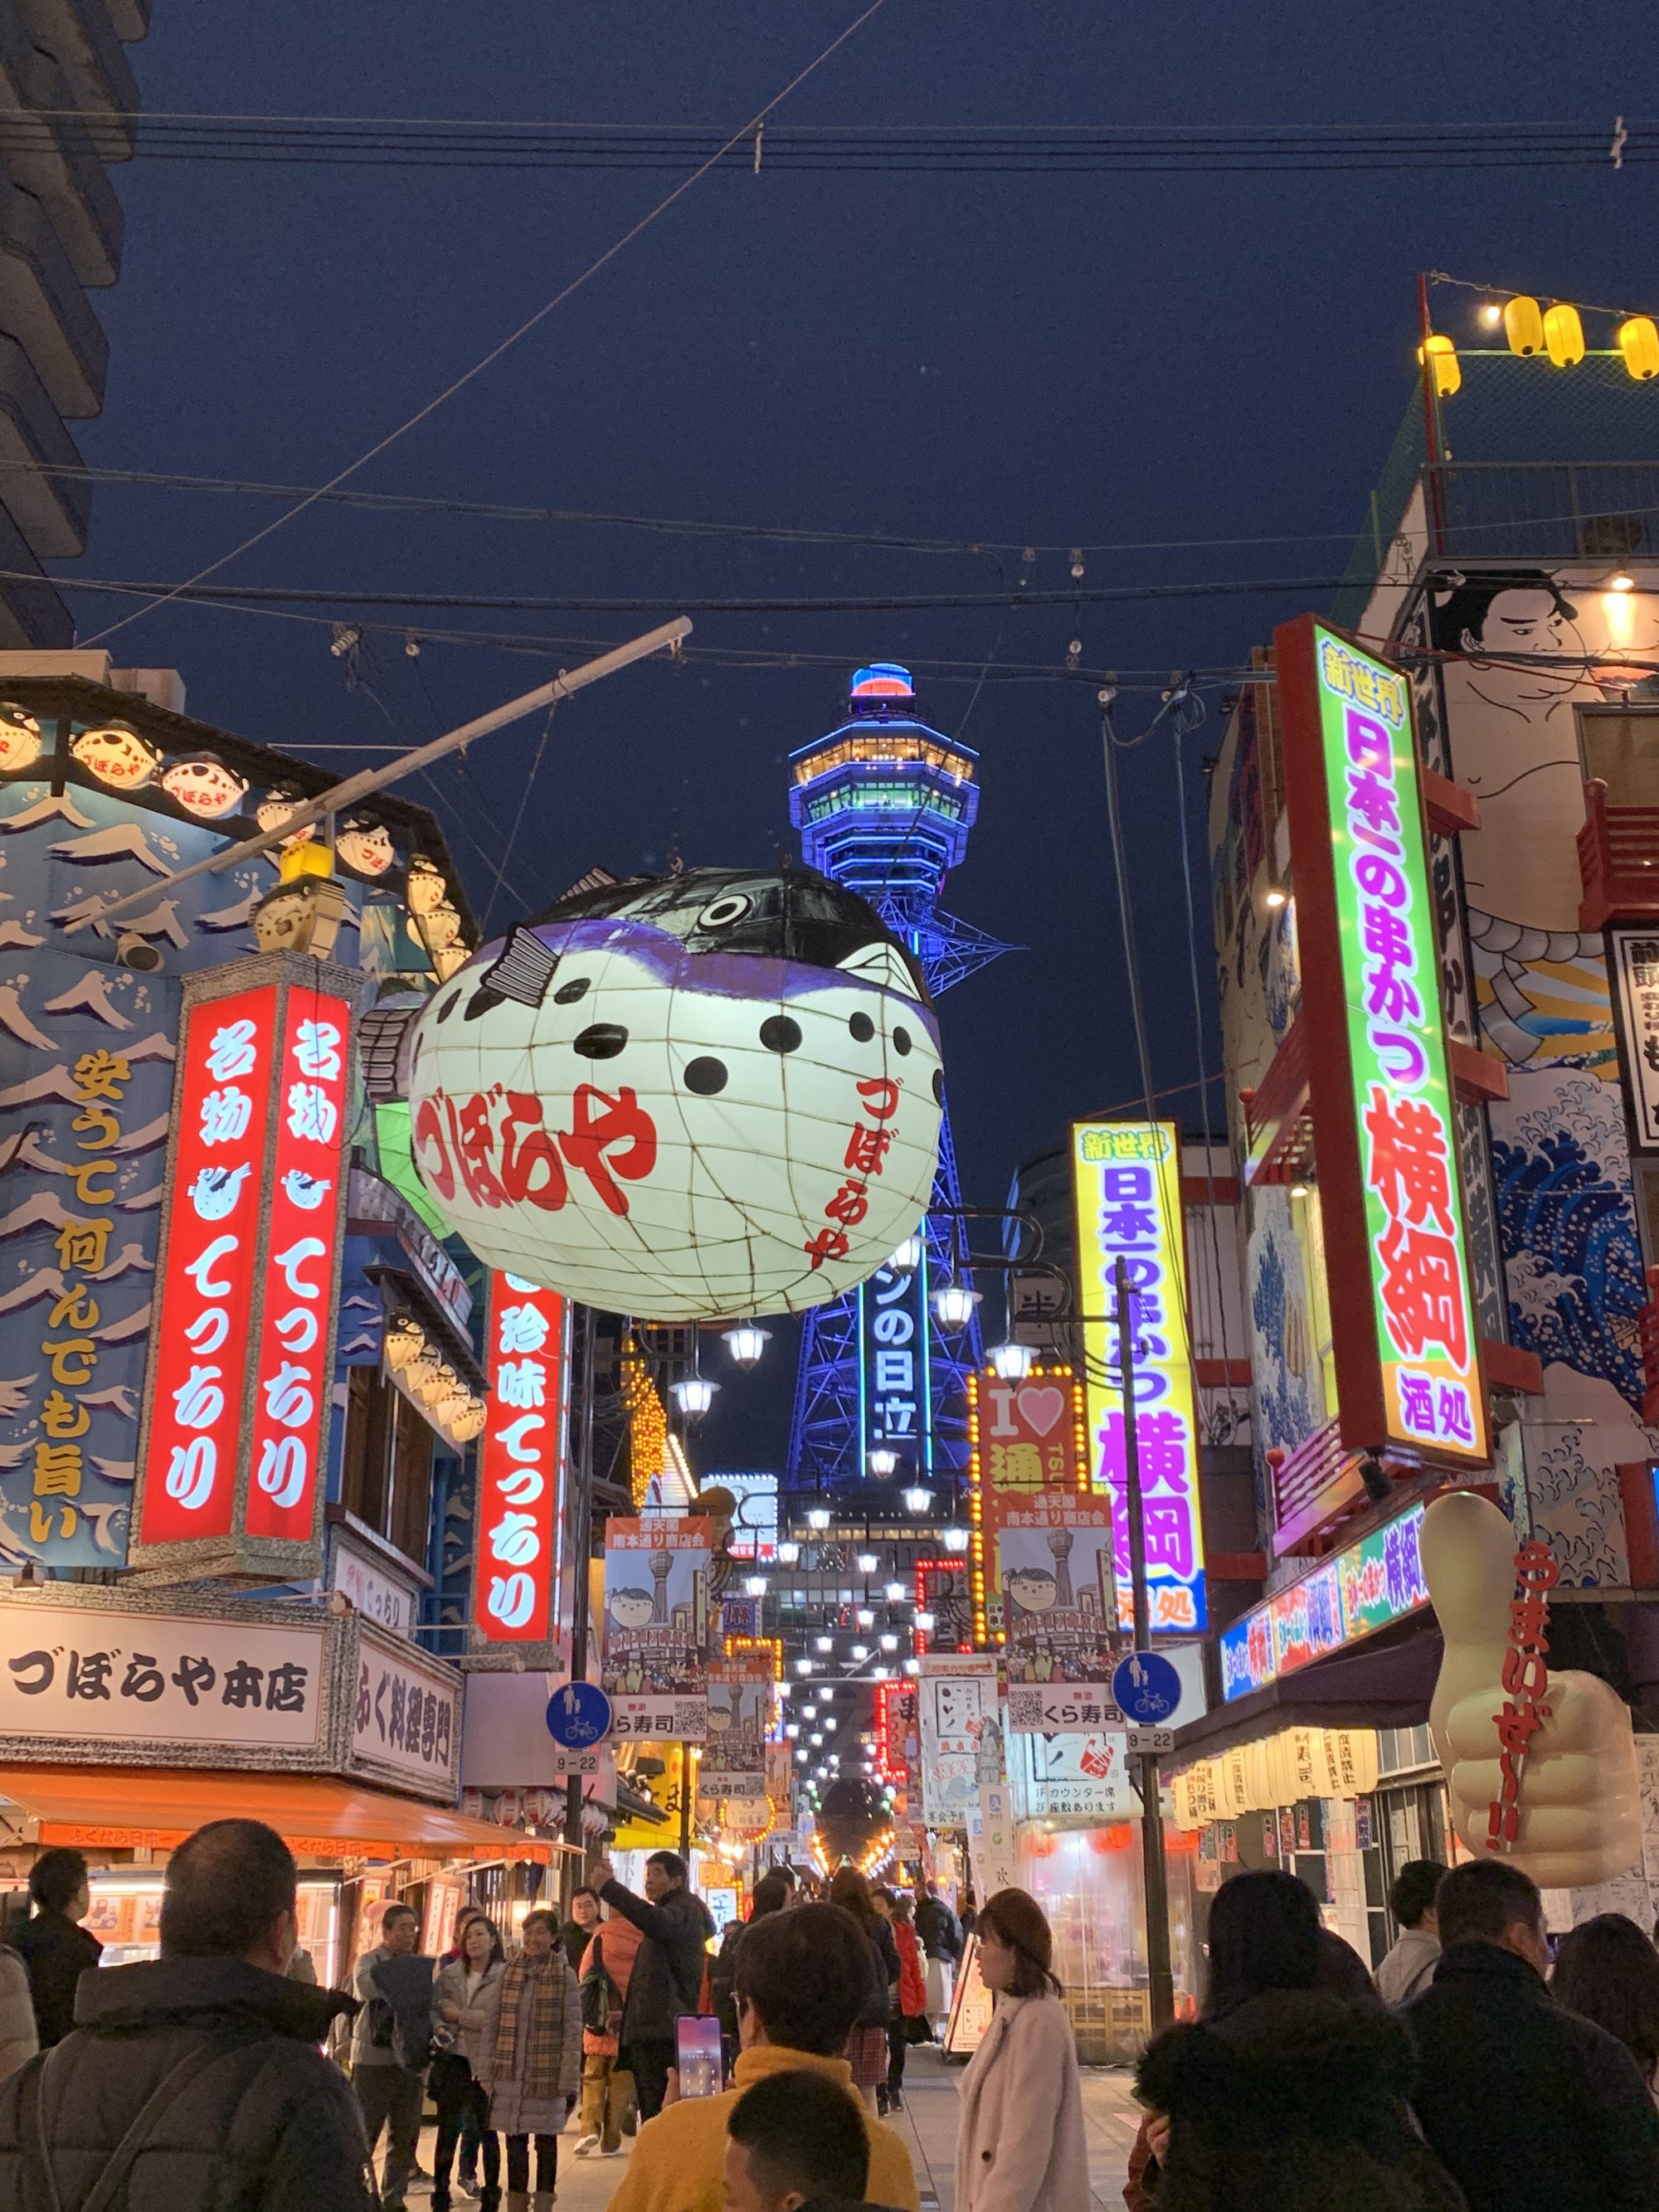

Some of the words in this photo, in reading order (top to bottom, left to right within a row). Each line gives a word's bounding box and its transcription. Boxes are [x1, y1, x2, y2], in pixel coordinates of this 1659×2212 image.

[1322, 644, 1404, 725] 新世界
[1345, 707, 1424, 1084] 日本一の串かつ
[200, 1018, 257, 1146] 名物
[285, 1018, 342, 1145] 名物
[415, 1082, 658, 1217] づぼらや
[804, 1077, 905, 1270] づぼらや
[1082, 1130, 1169, 1162] 新世界
[1365, 1086, 1467, 1370] 横綱
[166, 1234, 239, 1510] てっちり
[258, 1237, 328, 1510] てっちり
[1400, 1372, 1472, 1441] 酒処
[988, 1388, 1019, 1437] I
[487, 1301, 550, 1628] 珍味てっちり
[640, 1519, 679, 1532] 通天閣
[1034, 1495, 1076, 1509] 通天閣
[7, 1646, 309, 1714] づぼらや本店
[354, 1660, 451, 1767] ふぐ料理専門
[1044, 1704, 1125, 1724] くら寿司
[609, 1714, 674, 1733] ら寿司
[1128, 1733, 1171, 1748] 9-22
[557, 1757, 596, 1771] 9-22
[700, 1783, 746, 1796] くら寿司
[1049, 1787, 1116, 1798] カウンター席
